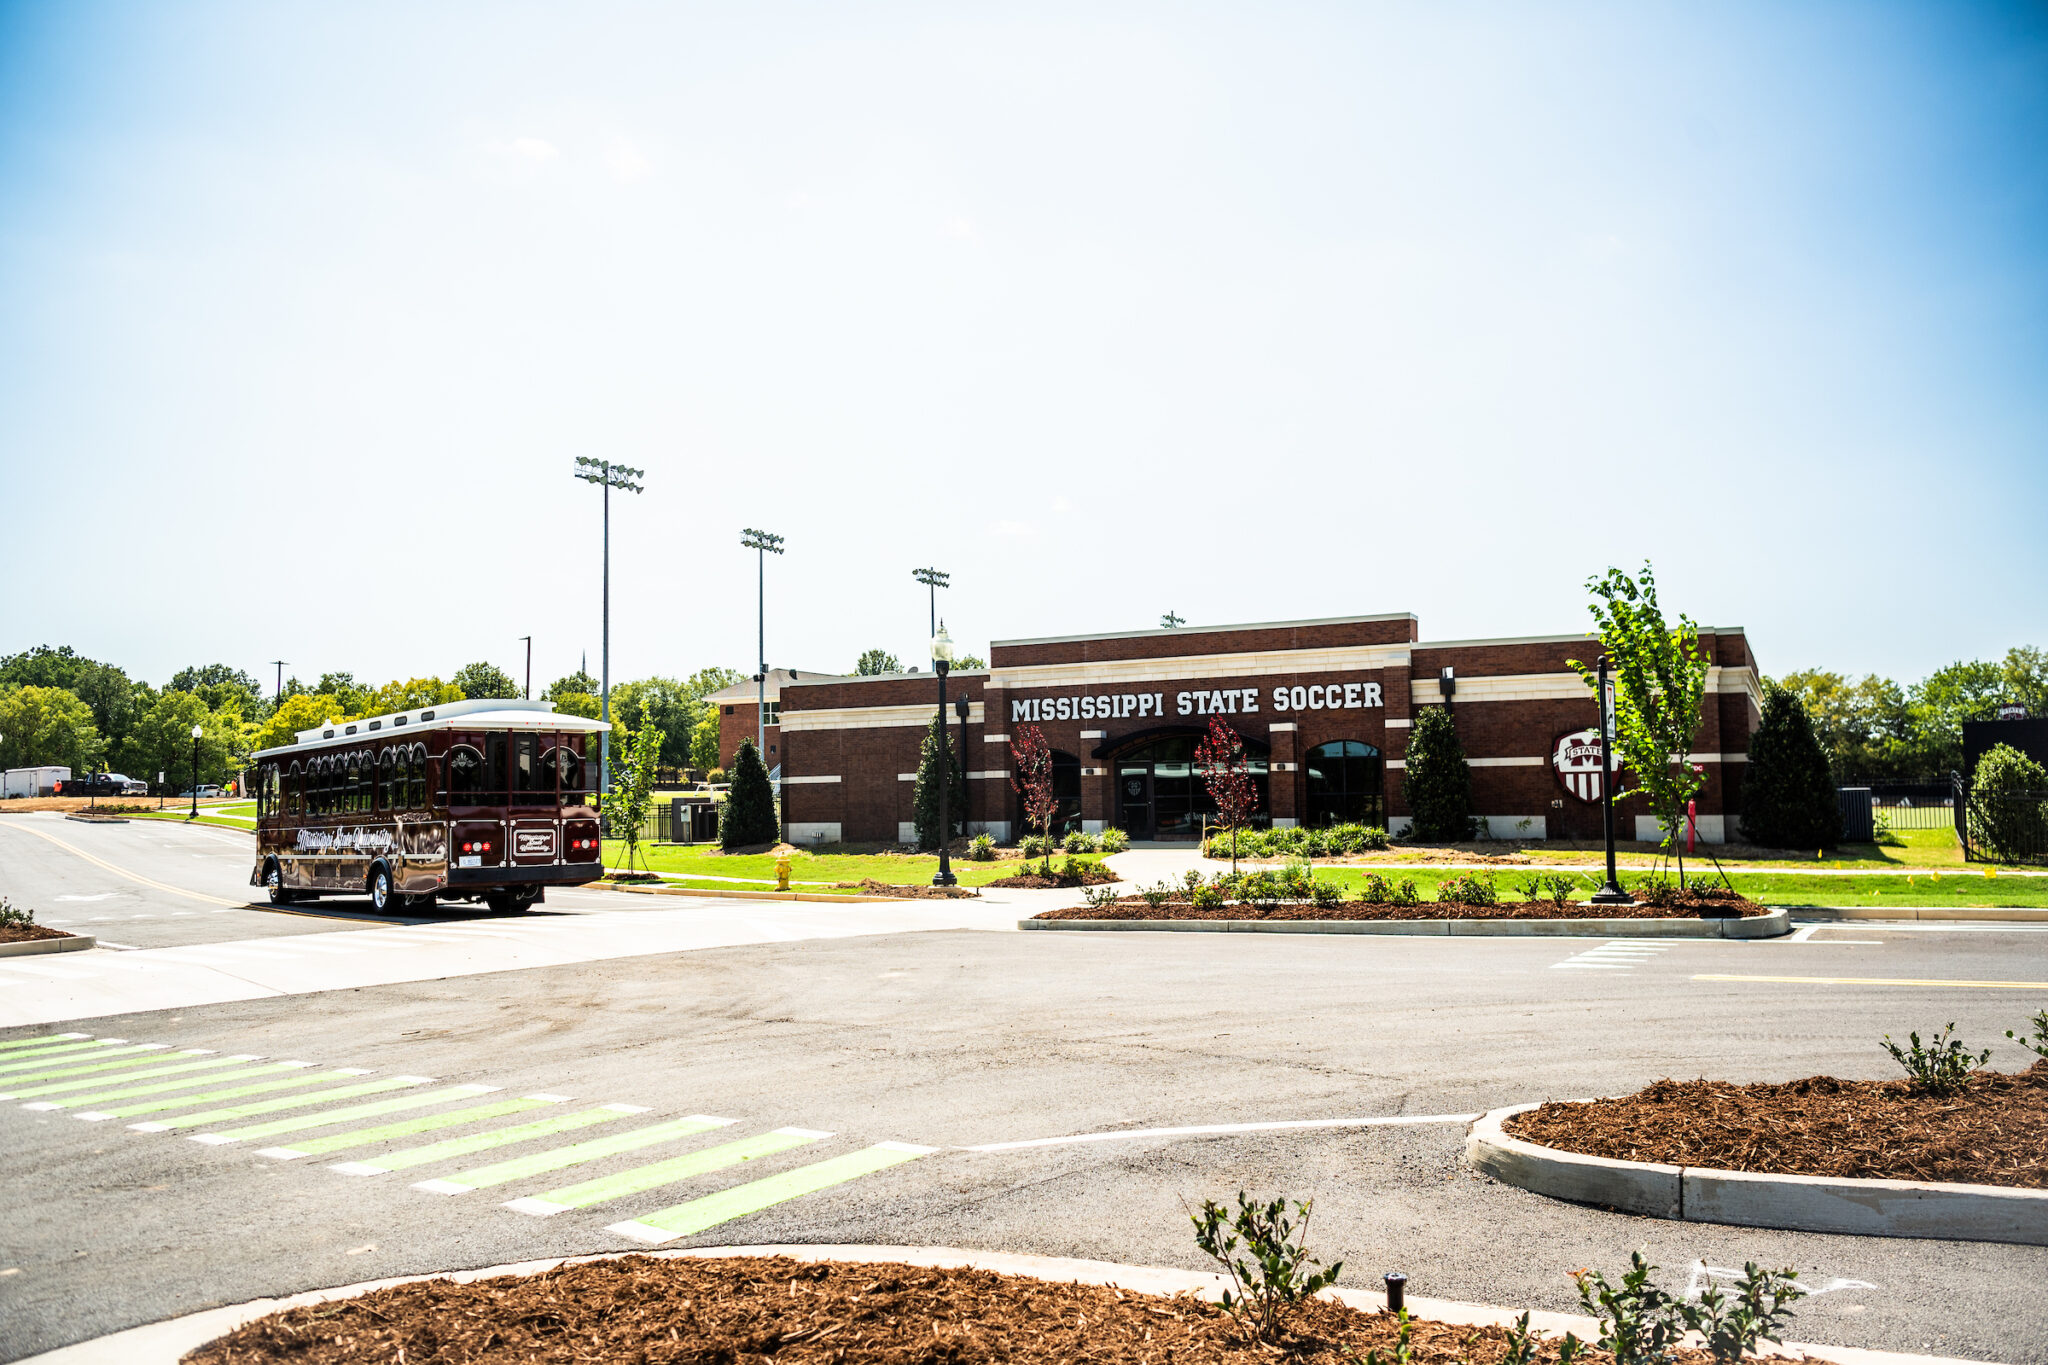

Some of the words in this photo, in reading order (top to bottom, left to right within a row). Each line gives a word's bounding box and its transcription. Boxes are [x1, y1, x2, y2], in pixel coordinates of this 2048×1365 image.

[1012, 693, 1163, 722] MISSISSIPPI
[1177, 688, 1259, 715] STATE
[1273, 682, 1383, 711] SOCCER
[1572, 747, 1602, 755] STATE
[333, 826, 353, 850] State
[352, 827, 393, 852] University
